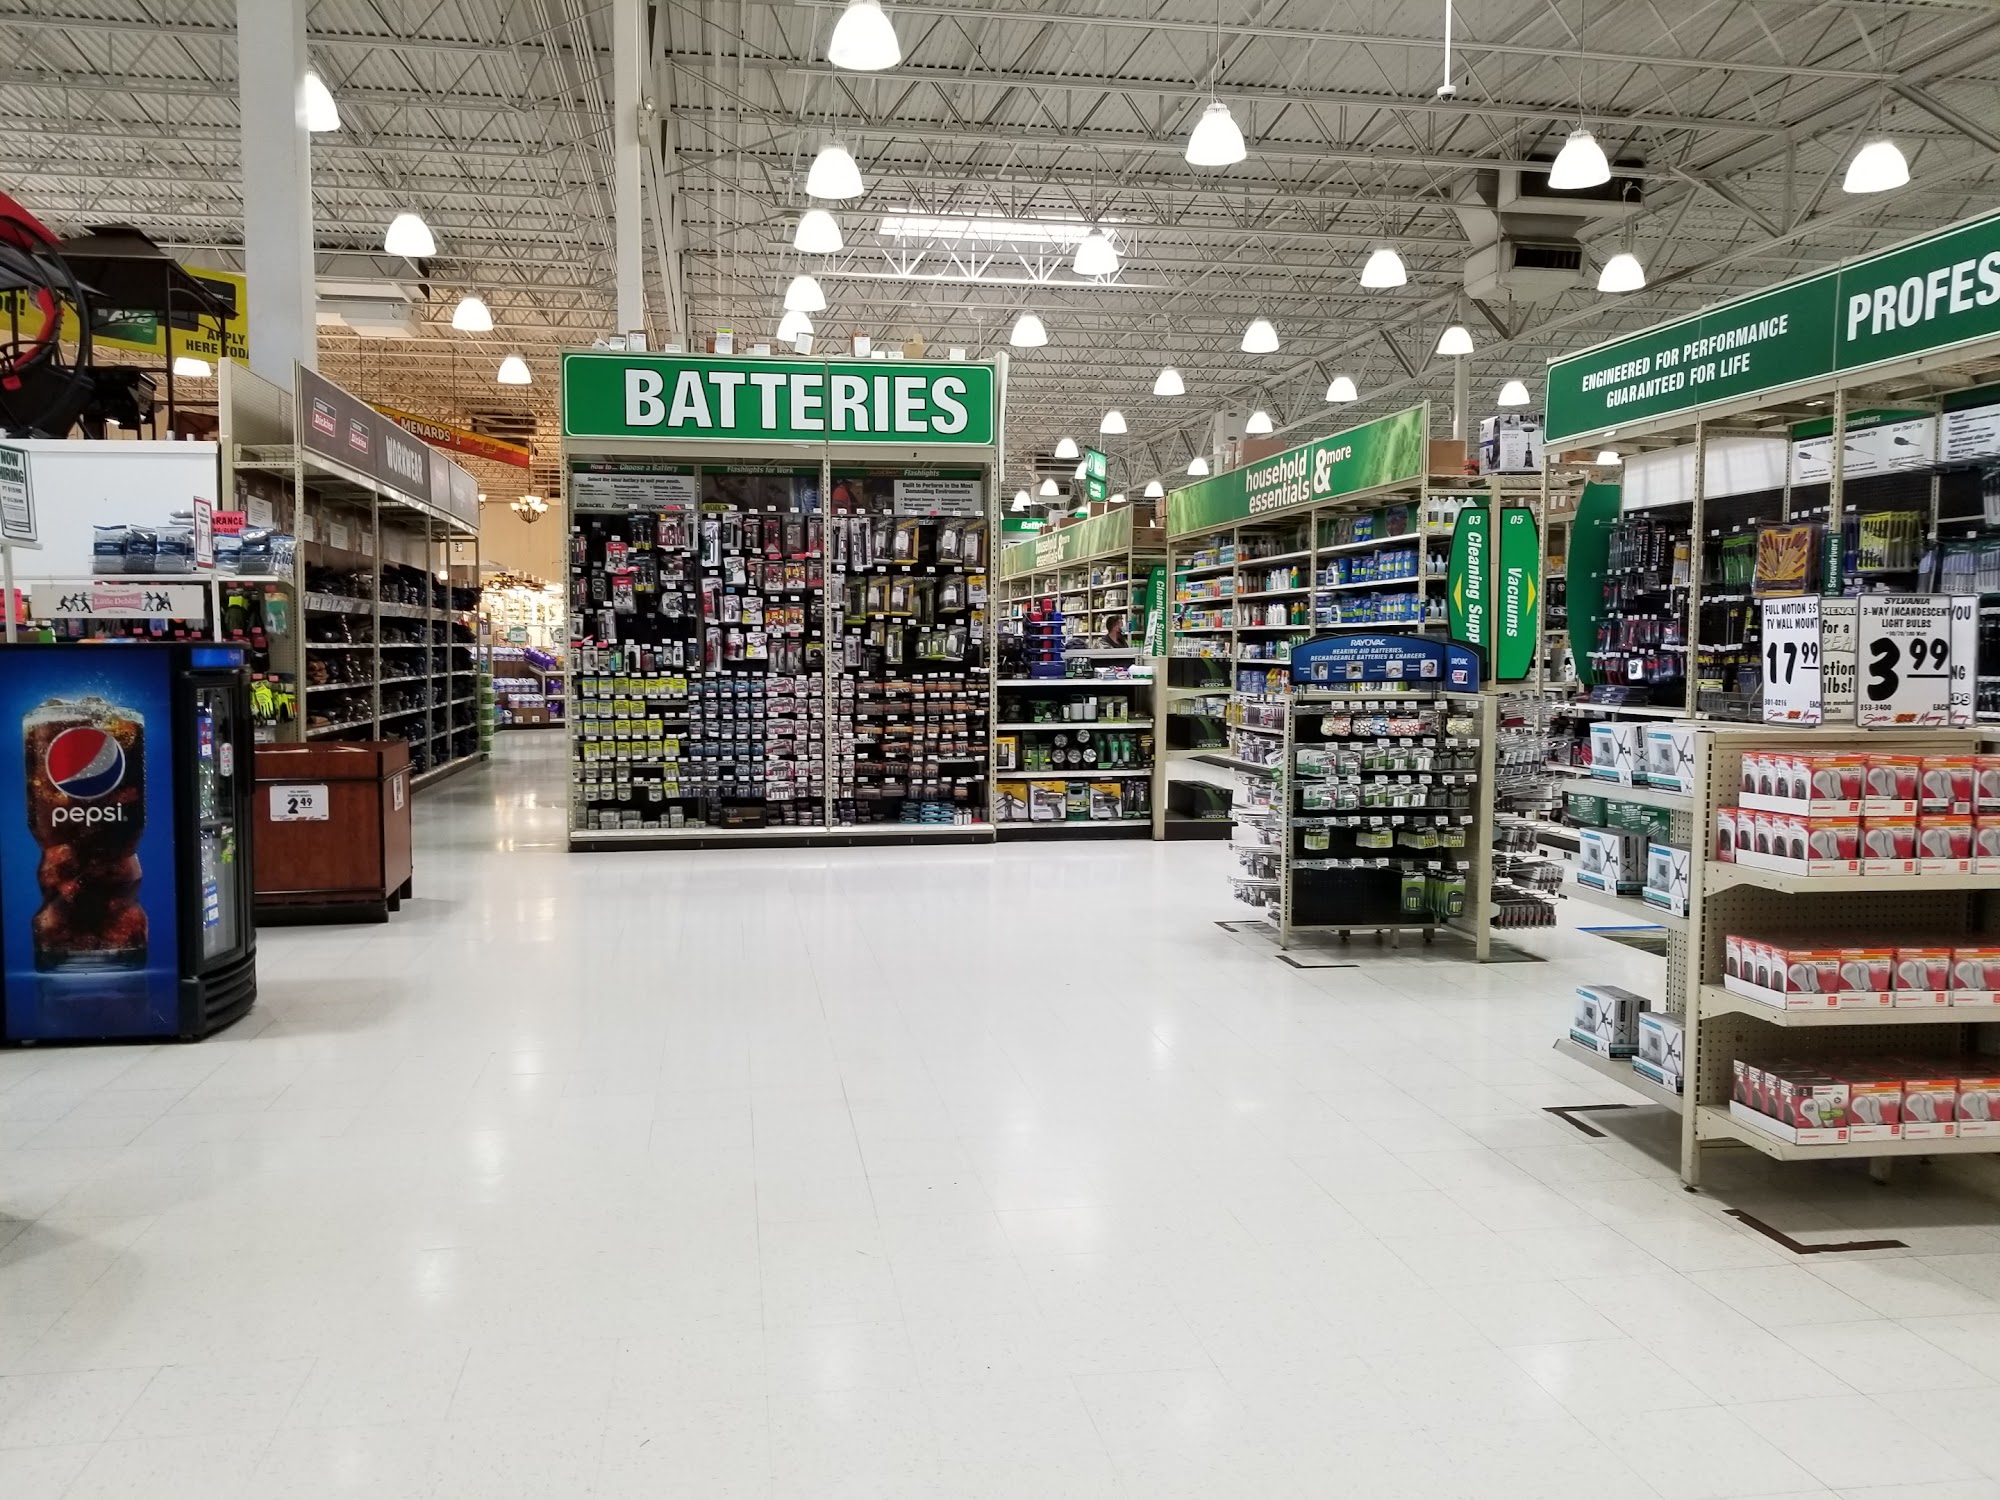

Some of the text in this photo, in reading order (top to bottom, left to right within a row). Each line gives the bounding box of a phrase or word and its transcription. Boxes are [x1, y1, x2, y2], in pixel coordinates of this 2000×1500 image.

[1847, 251, 2000, 341] PROFES
[186, 339, 218, 355] HERE
[1582, 314, 1789, 392] ENGINEERED FOR PERFORMANCE
[1606, 353, 1750, 408] GUARANTEED FOR LIFE
[623, 368, 969, 434] BATTERIES
[314, 413, 334, 431] Dickies
[400, 417, 451, 442] MENARDS
[0, 450, 19, 467] NOW
[385, 435, 424, 485] WORKWEAR
[652, 464, 679, 473] Battery
[727, 466, 763, 474] Flashlights
[777, 466, 794, 474] Work
[904, 469, 940, 477] Flashlights
[1246, 445, 1352, 494] household & more
[1249, 476, 1310, 514] essentials
[1468, 515, 1481, 525] 03
[1510, 515, 1524, 525] 05
[1466, 531, 1482, 600] Cleaning
[1828, 538, 1839, 588] Screwdrivers
[1506, 568, 1522, 637] Vacuums
[1765, 604, 1780, 615] FULL
[1781, 603, 1806, 615] MOTION
[1884, 597, 1931, 605] SYLVANIA
[1863, 607, 1951, 617] 3-WAY INCANDESCENT
[1767, 617, 1818, 629] TV WALL MOUNT
[1822, 619, 1850, 633] for a
[1882, 619, 1931, 628] LIGHT BULBS
[1350, 638, 1386, 647] RAYOVAC
[1310, 654, 1356, 662] RECHARGEABLE
[1860, 703, 1892, 711] 353-3400
[52, 802, 122, 827] pepsi
